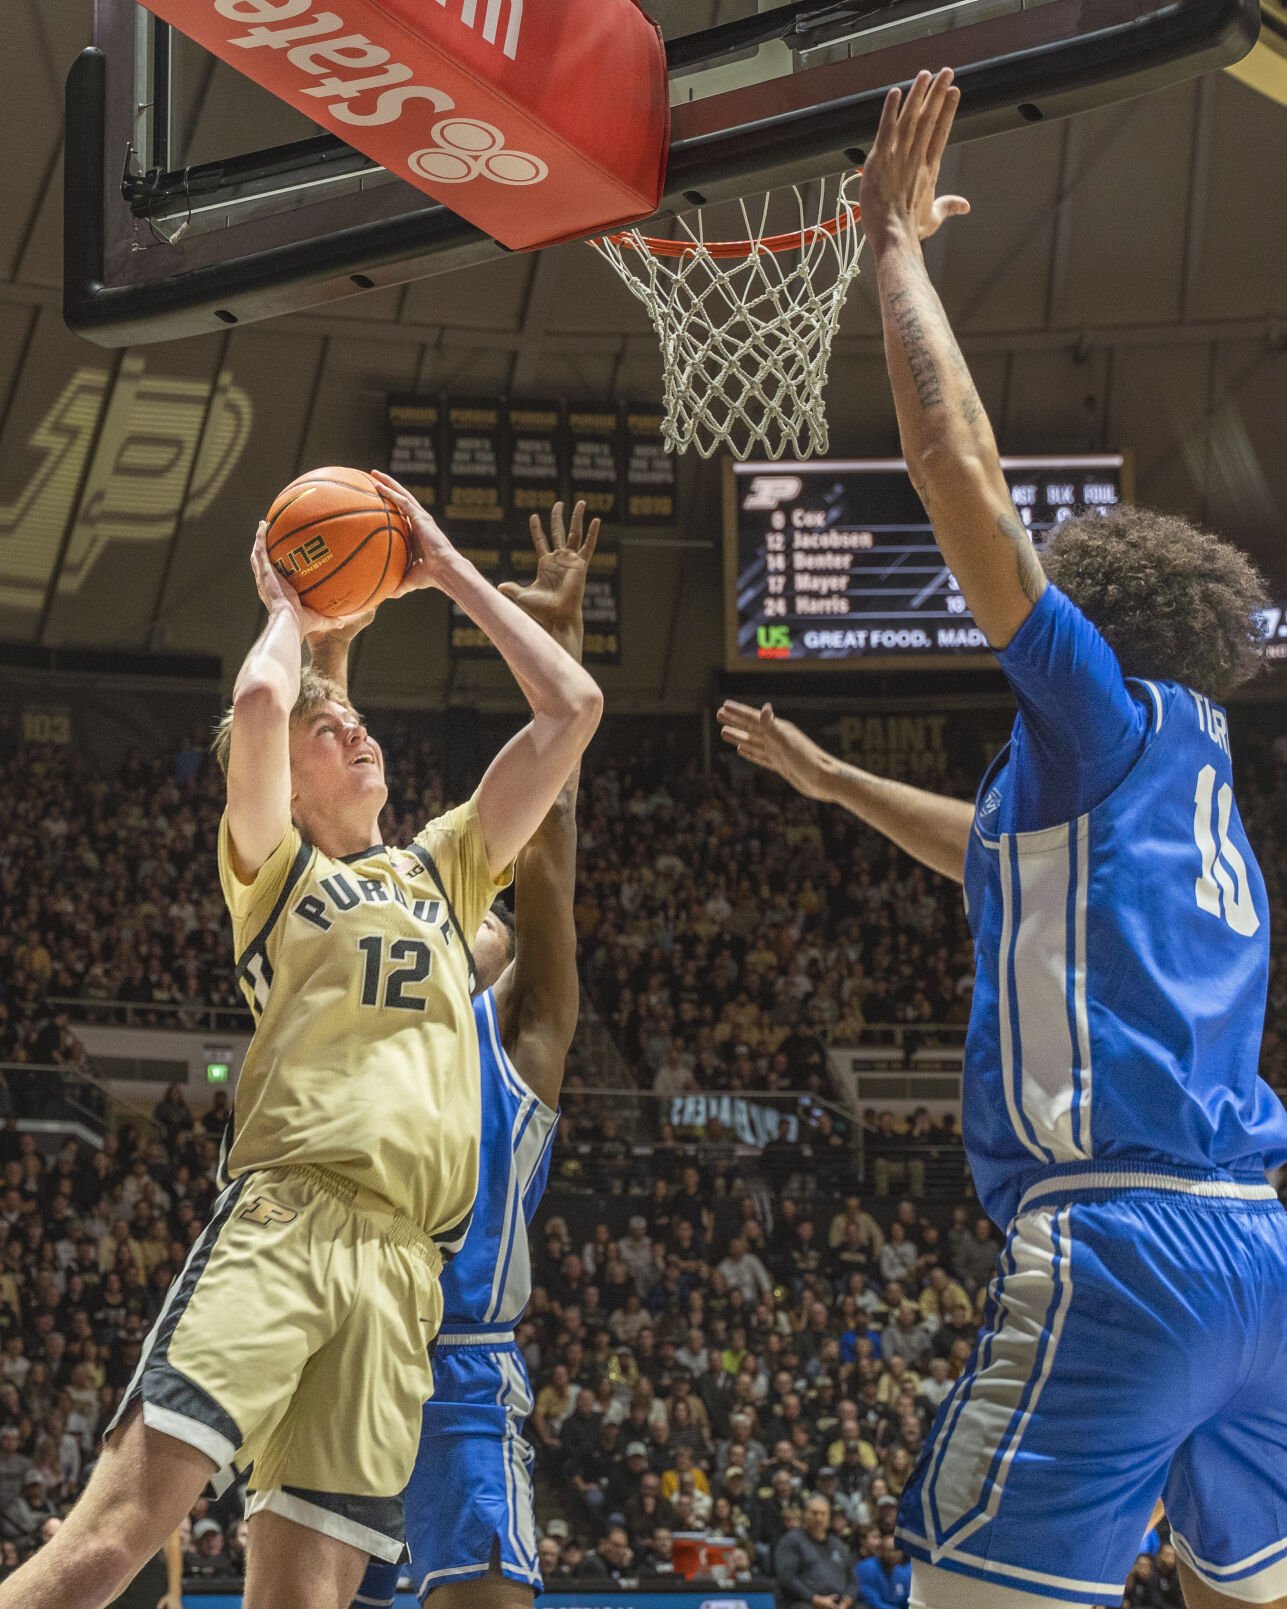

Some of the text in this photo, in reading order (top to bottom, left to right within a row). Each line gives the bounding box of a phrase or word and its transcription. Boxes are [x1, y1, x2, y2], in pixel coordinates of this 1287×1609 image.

[791, 508, 826, 528] Cox
[765, 530, 873, 551] 12 Jacobsen
[273, 535, 331, 577] LITE
[766, 552, 787, 571] 14
[767, 573, 850, 595] 17 Mayer
[764, 595, 850, 617] 24 Harris
[803, 630, 867, 649] GREAT
[870, 629, 932, 648] FOOD.
[1188, 687, 1233, 766] TUR
[357, 935, 432, 1012] 12
